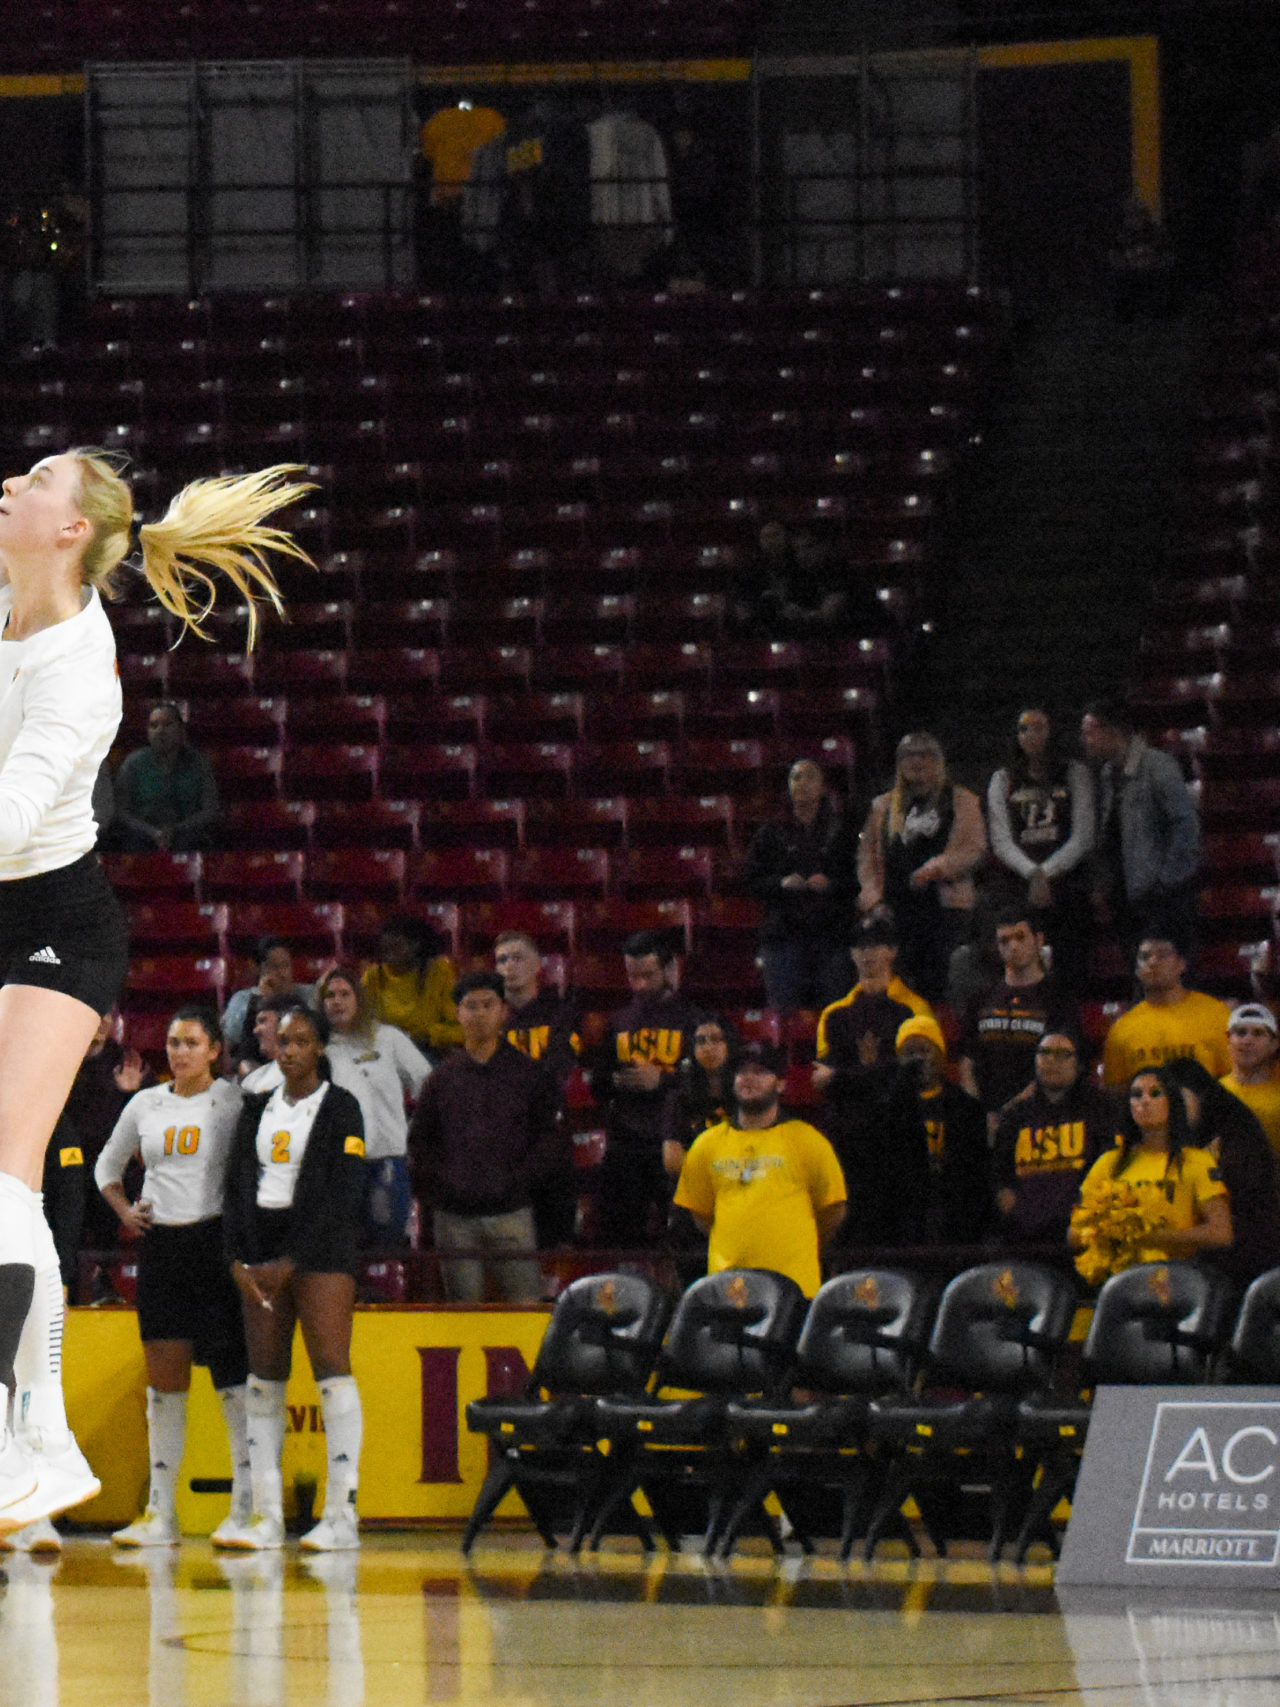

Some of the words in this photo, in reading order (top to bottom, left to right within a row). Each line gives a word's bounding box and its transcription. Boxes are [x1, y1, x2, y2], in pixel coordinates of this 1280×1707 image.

[163, 1126, 201, 1156] 10
[271, 1130, 291, 1163] 2
[1014, 1121, 1087, 1163] ASU
[1164, 1426, 1279, 1484] AC
[1157, 1491, 1269, 1511] HOTELS
[1149, 1537, 1260, 1557] MARRIOTT
